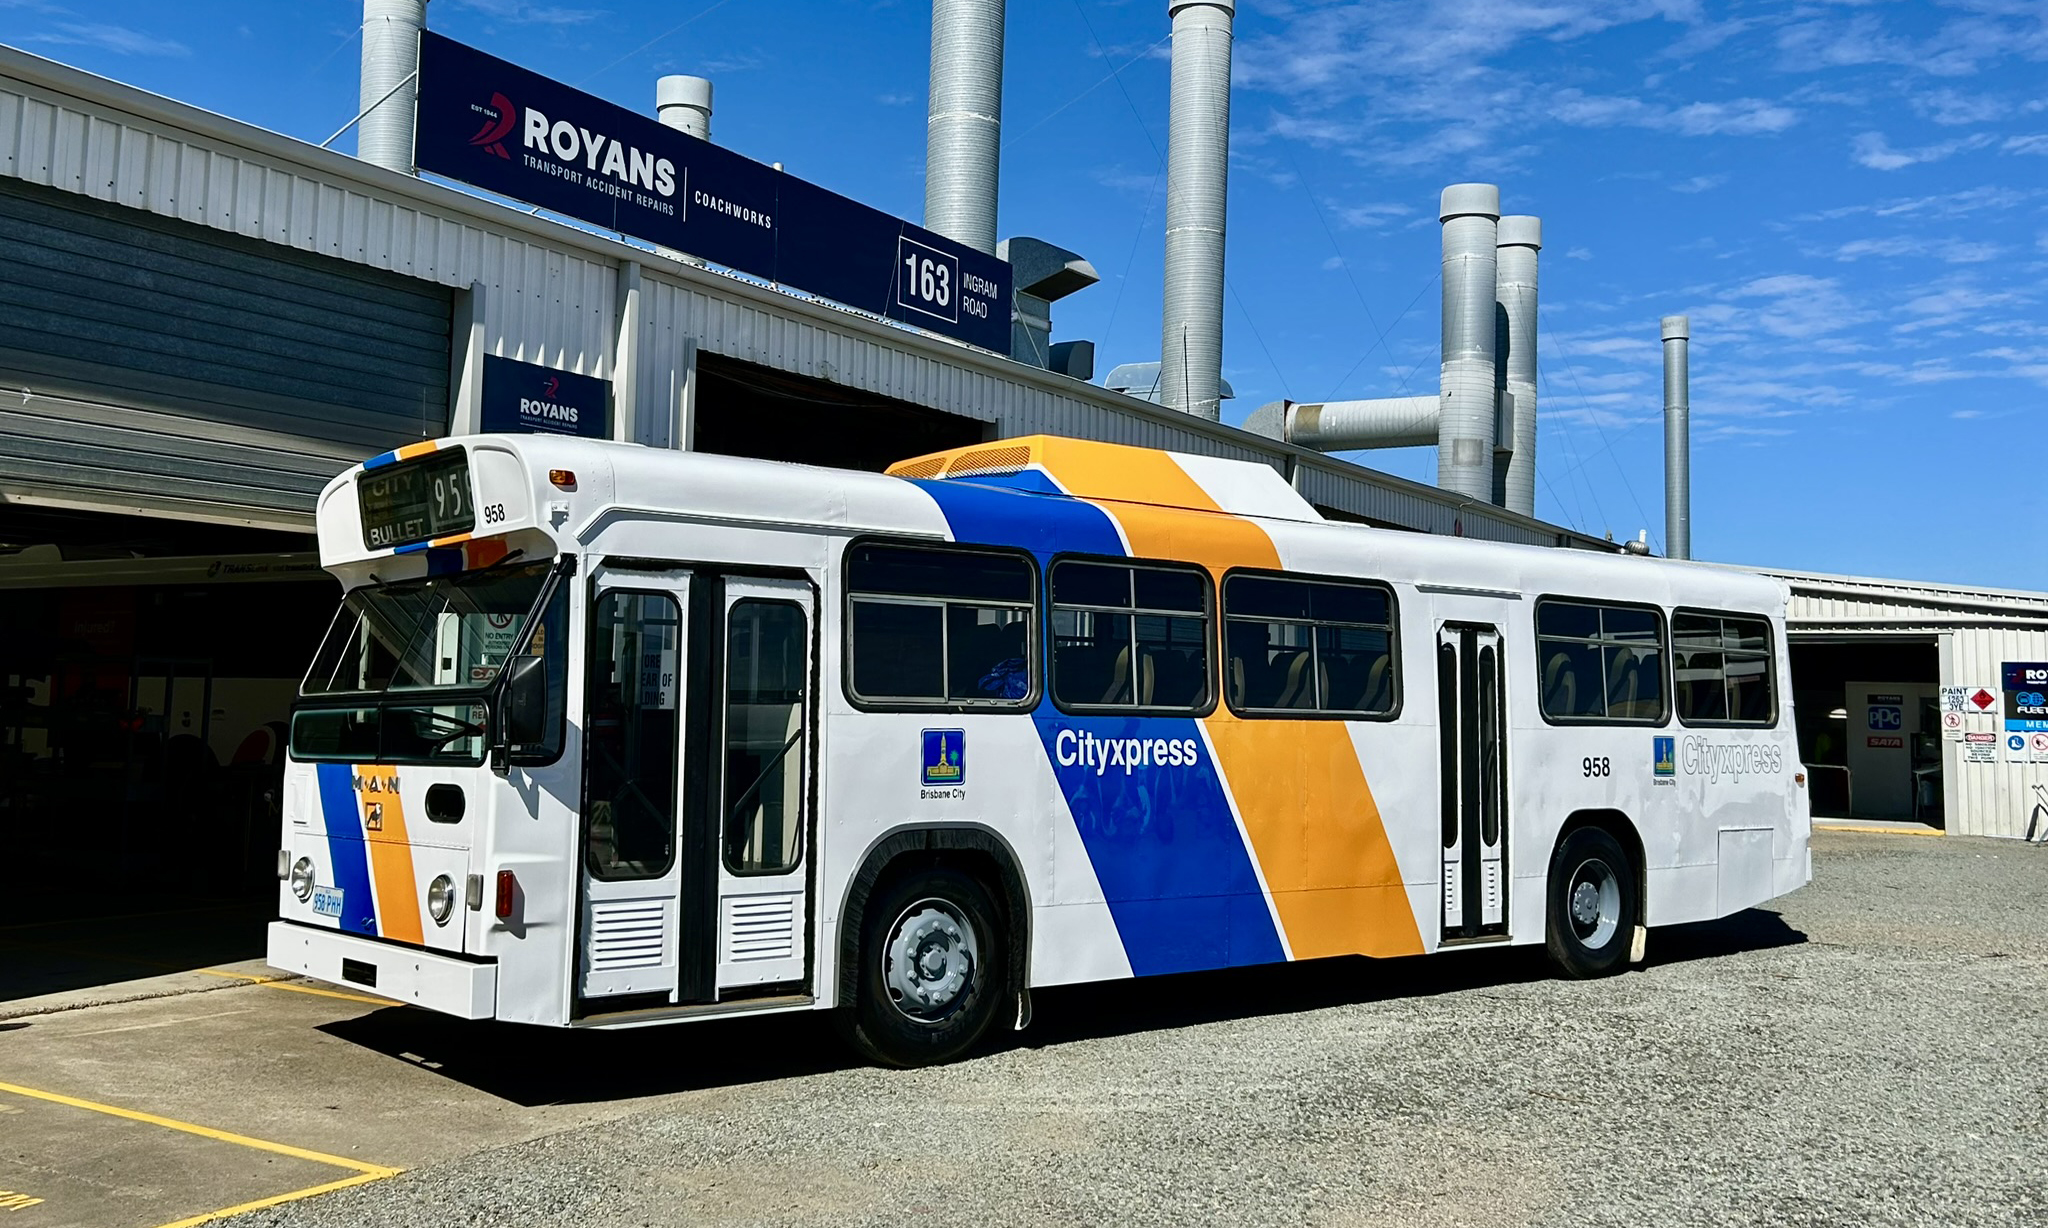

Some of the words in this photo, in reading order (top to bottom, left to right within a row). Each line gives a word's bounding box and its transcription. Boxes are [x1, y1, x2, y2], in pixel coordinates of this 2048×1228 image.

[471, 104, 483, 113] EST
[523, 106, 676, 197] ROYANS
[523, 153, 583, 185] TRANSPORT
[586, 176, 633, 201] ACCIDENT
[636, 193, 675, 217] REPAIRS
[694, 189, 773, 229] COACHWORKS
[905, 253, 950, 307] 163
[963, 272, 998, 300] INGRAM
[963, 295, 988, 319] ROAD
[520, 397, 579, 423] ROYANS
[372, 473, 412, 497] CITY
[484, 503, 506, 524] 958
[370, 517, 424, 546] BULLET
[485, 632, 495, 640] NO
[662, 672, 673, 687] OF
[1941, 687, 1968, 695] PAINT
[1948, 695, 1965, 704] 1263
[1869, 708, 1901, 729] PPG
[1056, 728, 1198, 776] Cityxpress
[1870, 738, 1901, 747] SATA
[1582, 756, 1611, 778] 958
[1681, 734, 1782, 785] Cityxpress
[920, 788, 951, 800] Brisbane
[952, 788, 966, 801] City
[326, 895, 342, 915] PHH
